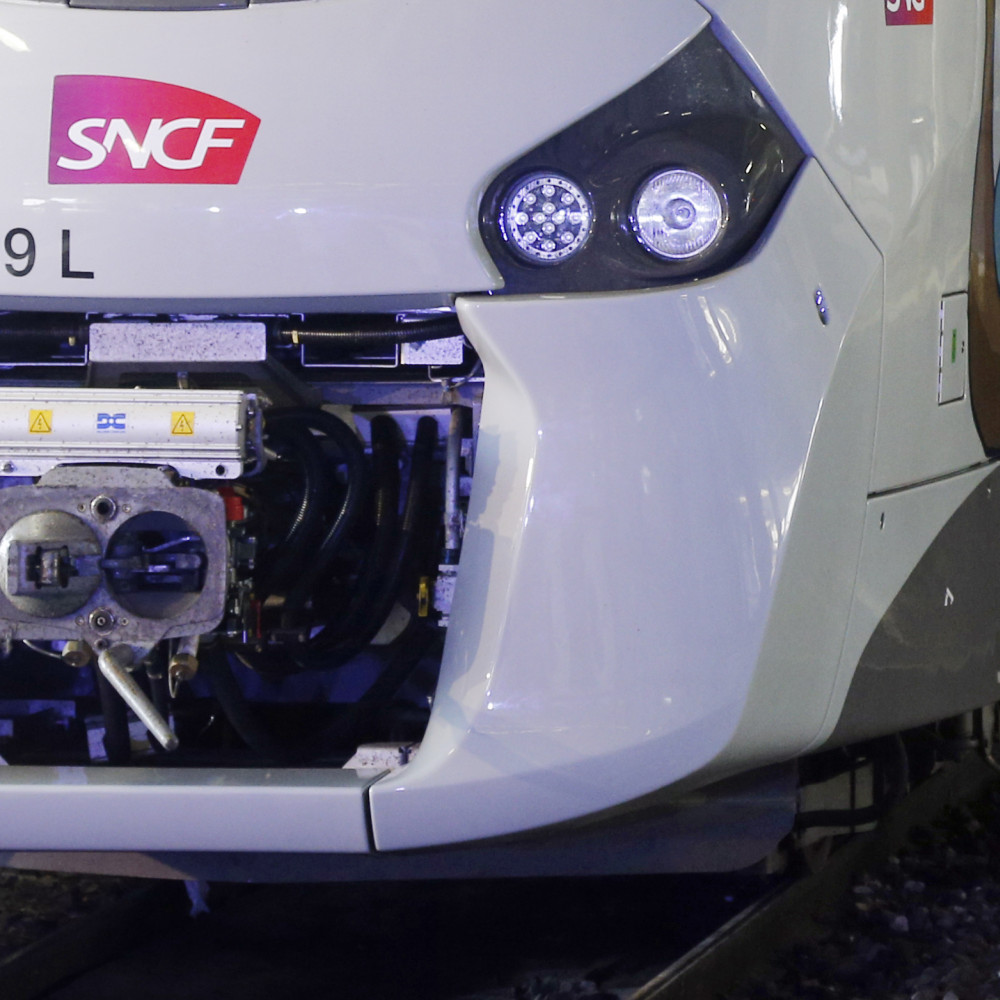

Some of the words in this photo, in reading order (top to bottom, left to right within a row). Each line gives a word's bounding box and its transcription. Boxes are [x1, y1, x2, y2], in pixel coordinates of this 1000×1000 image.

[56, 118, 245, 171] SNCF
[4, 228, 36, 278] 9
[62, 229, 95, 279] L
